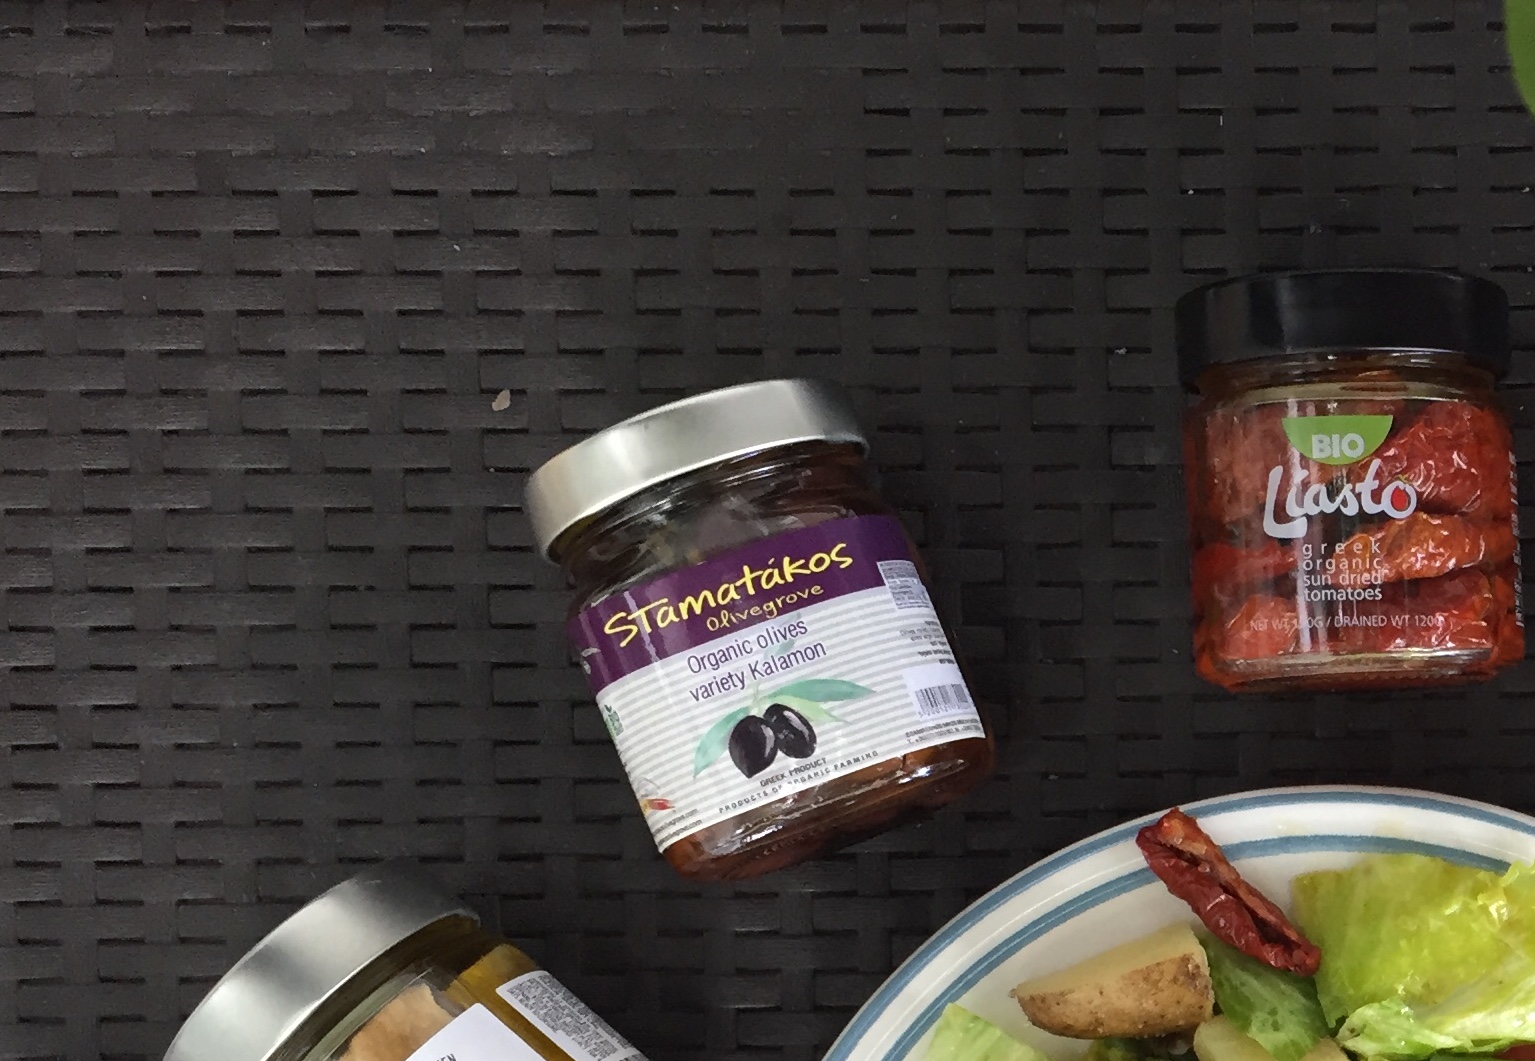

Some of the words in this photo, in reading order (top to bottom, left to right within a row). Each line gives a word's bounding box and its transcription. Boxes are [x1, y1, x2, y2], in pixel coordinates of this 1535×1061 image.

[1311, 433, 1365, 459] BIO
[1302, 538, 1380, 558] greek
[1302, 557, 1382, 572] organic
[1303, 574, 1331, 586] sun
[1339, 571, 1382, 585] dried
[1303, 587, 1383, 601] tomatoes
[1334, 615, 1387, 627] DRAINED
[1390, 615, 1410, 627] WT
[687, 638, 754, 674] Organic
[756, 619, 808, 650] olives
[689, 668, 746, 702] variety
[748, 641, 827, 682] Kalamon
[719, 789, 769, 814] PRODUCTS
[834, 750, 879, 770] FARMING
[760, 772, 787, 787] GREEK
[788, 757, 828, 777] PRODUCT
